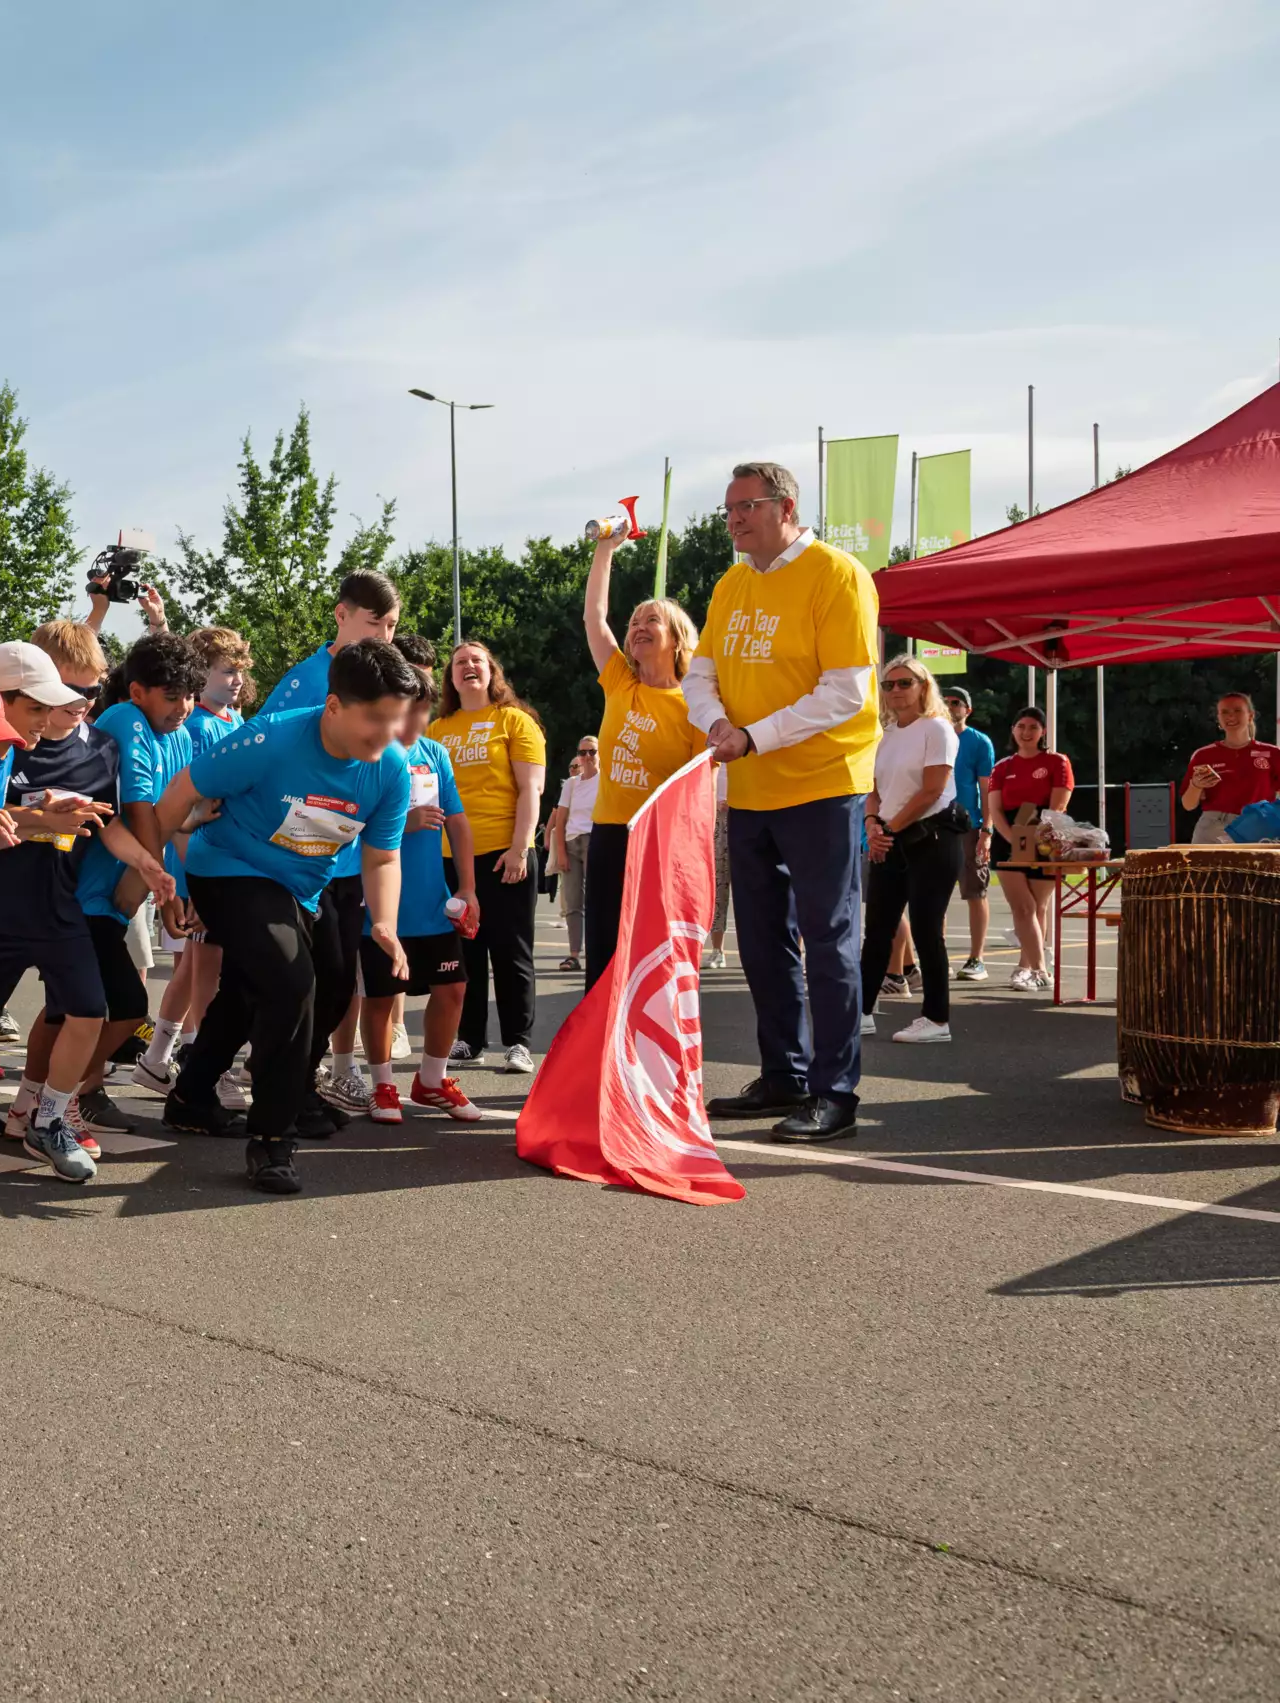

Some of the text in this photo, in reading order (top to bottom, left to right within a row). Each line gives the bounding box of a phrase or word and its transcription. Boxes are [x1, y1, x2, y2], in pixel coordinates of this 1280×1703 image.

[754, 608, 780, 636] Tag
[723, 633, 772, 658] 17 Zele
[441, 731, 491, 747] Ein Tag
[454, 744, 488, 763] Ziele
[610, 761, 650, 786] Werk
[281, 795, 303, 804] JAKO
